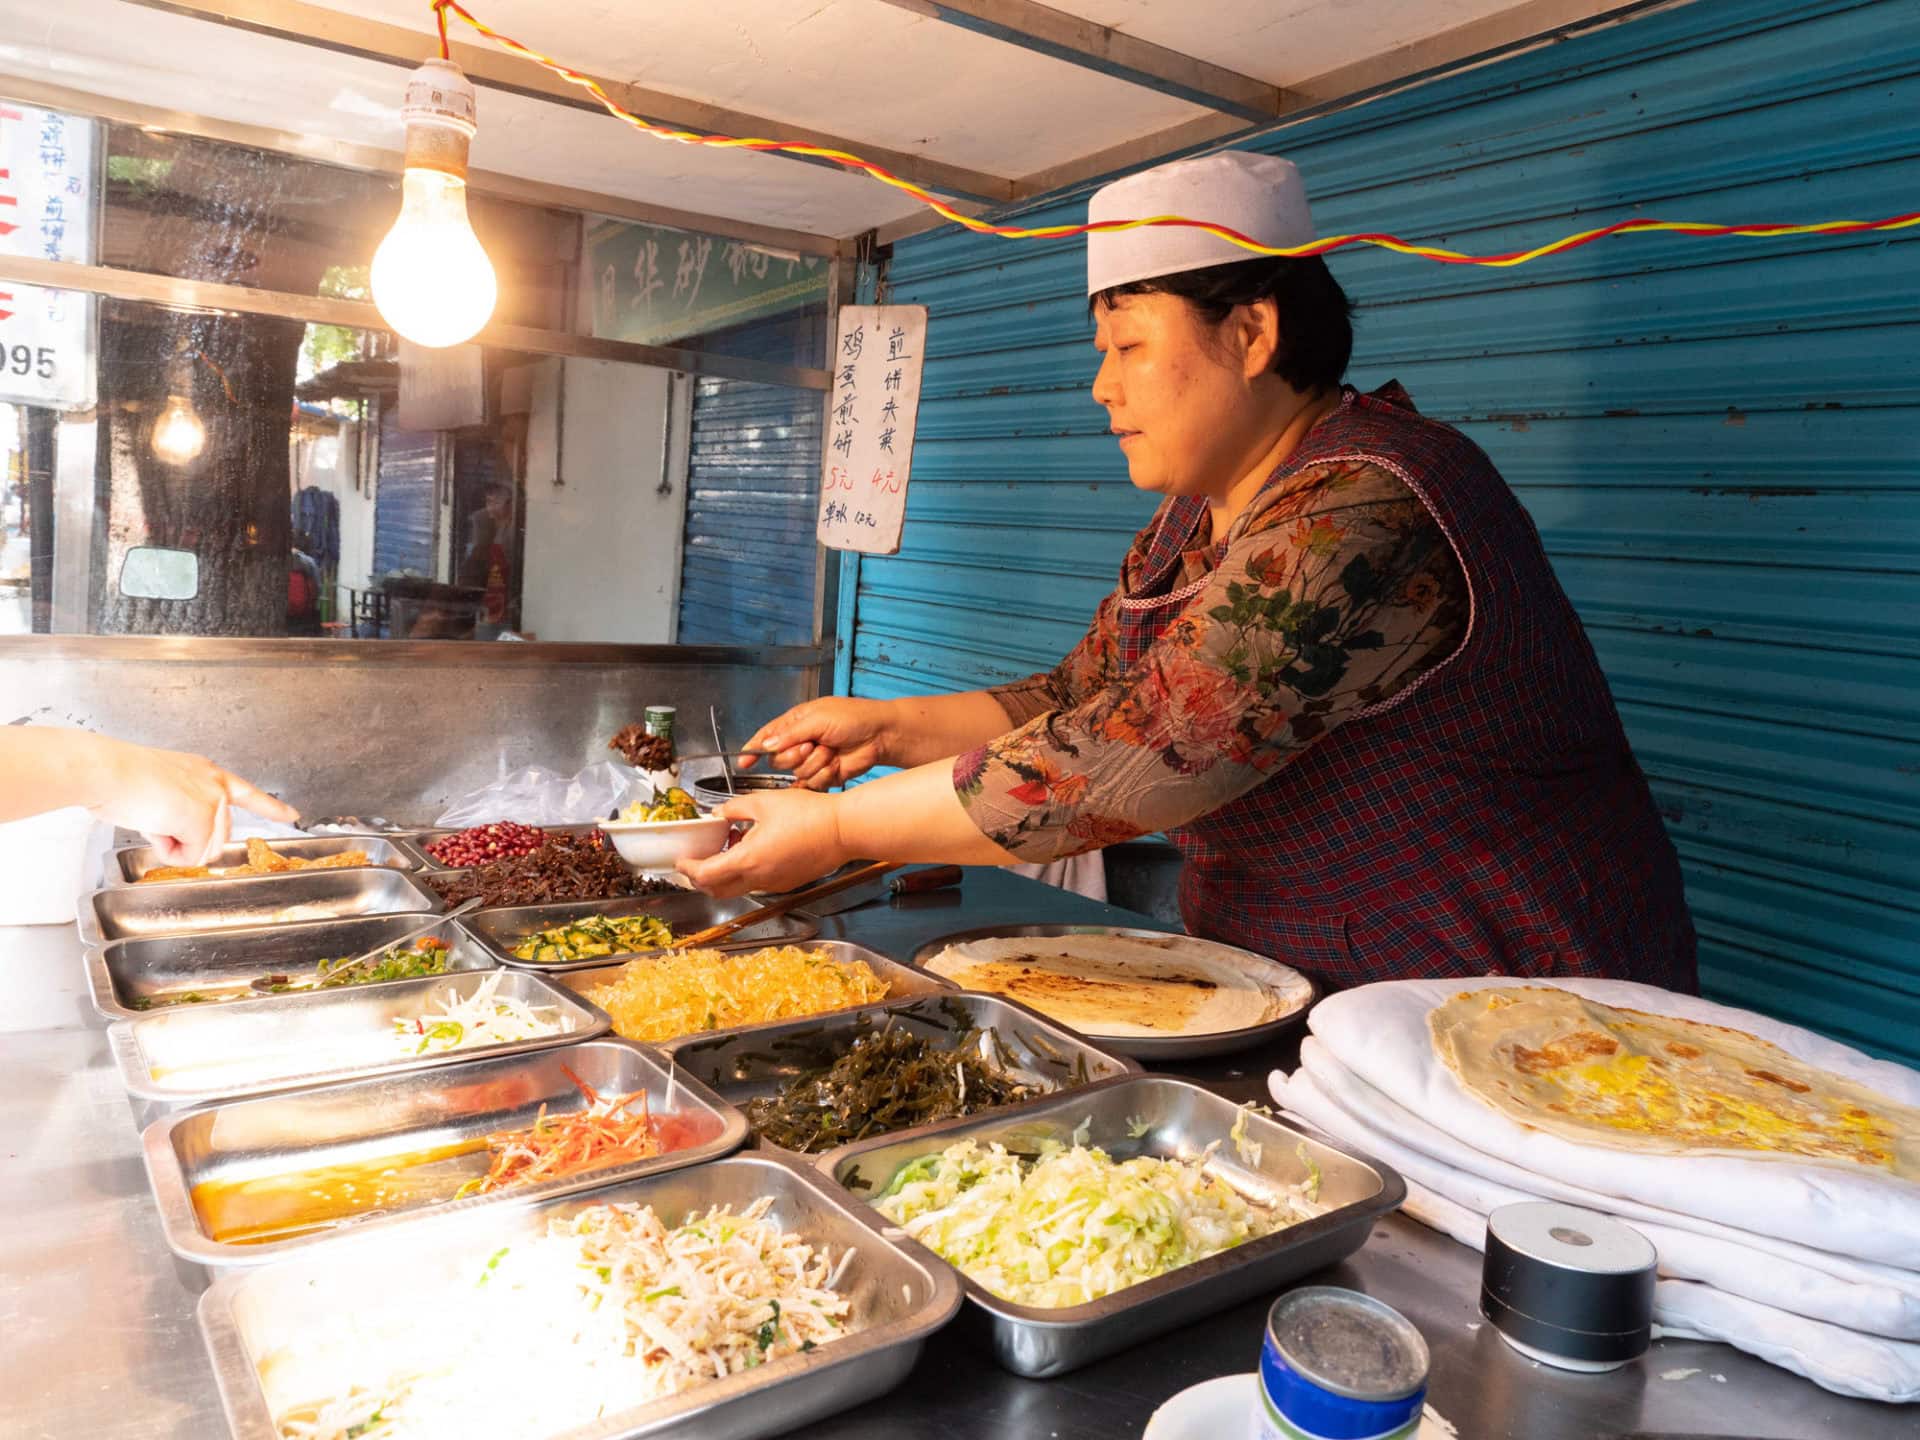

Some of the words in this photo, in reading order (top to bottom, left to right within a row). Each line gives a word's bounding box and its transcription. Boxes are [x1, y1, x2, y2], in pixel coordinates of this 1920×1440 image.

[832, 325, 865, 459] 鸡蛋煎饼
[877, 328, 913, 456] 煎饼夹菜
[823, 466, 854, 492] 5元
[871, 466, 903, 495] 4元
